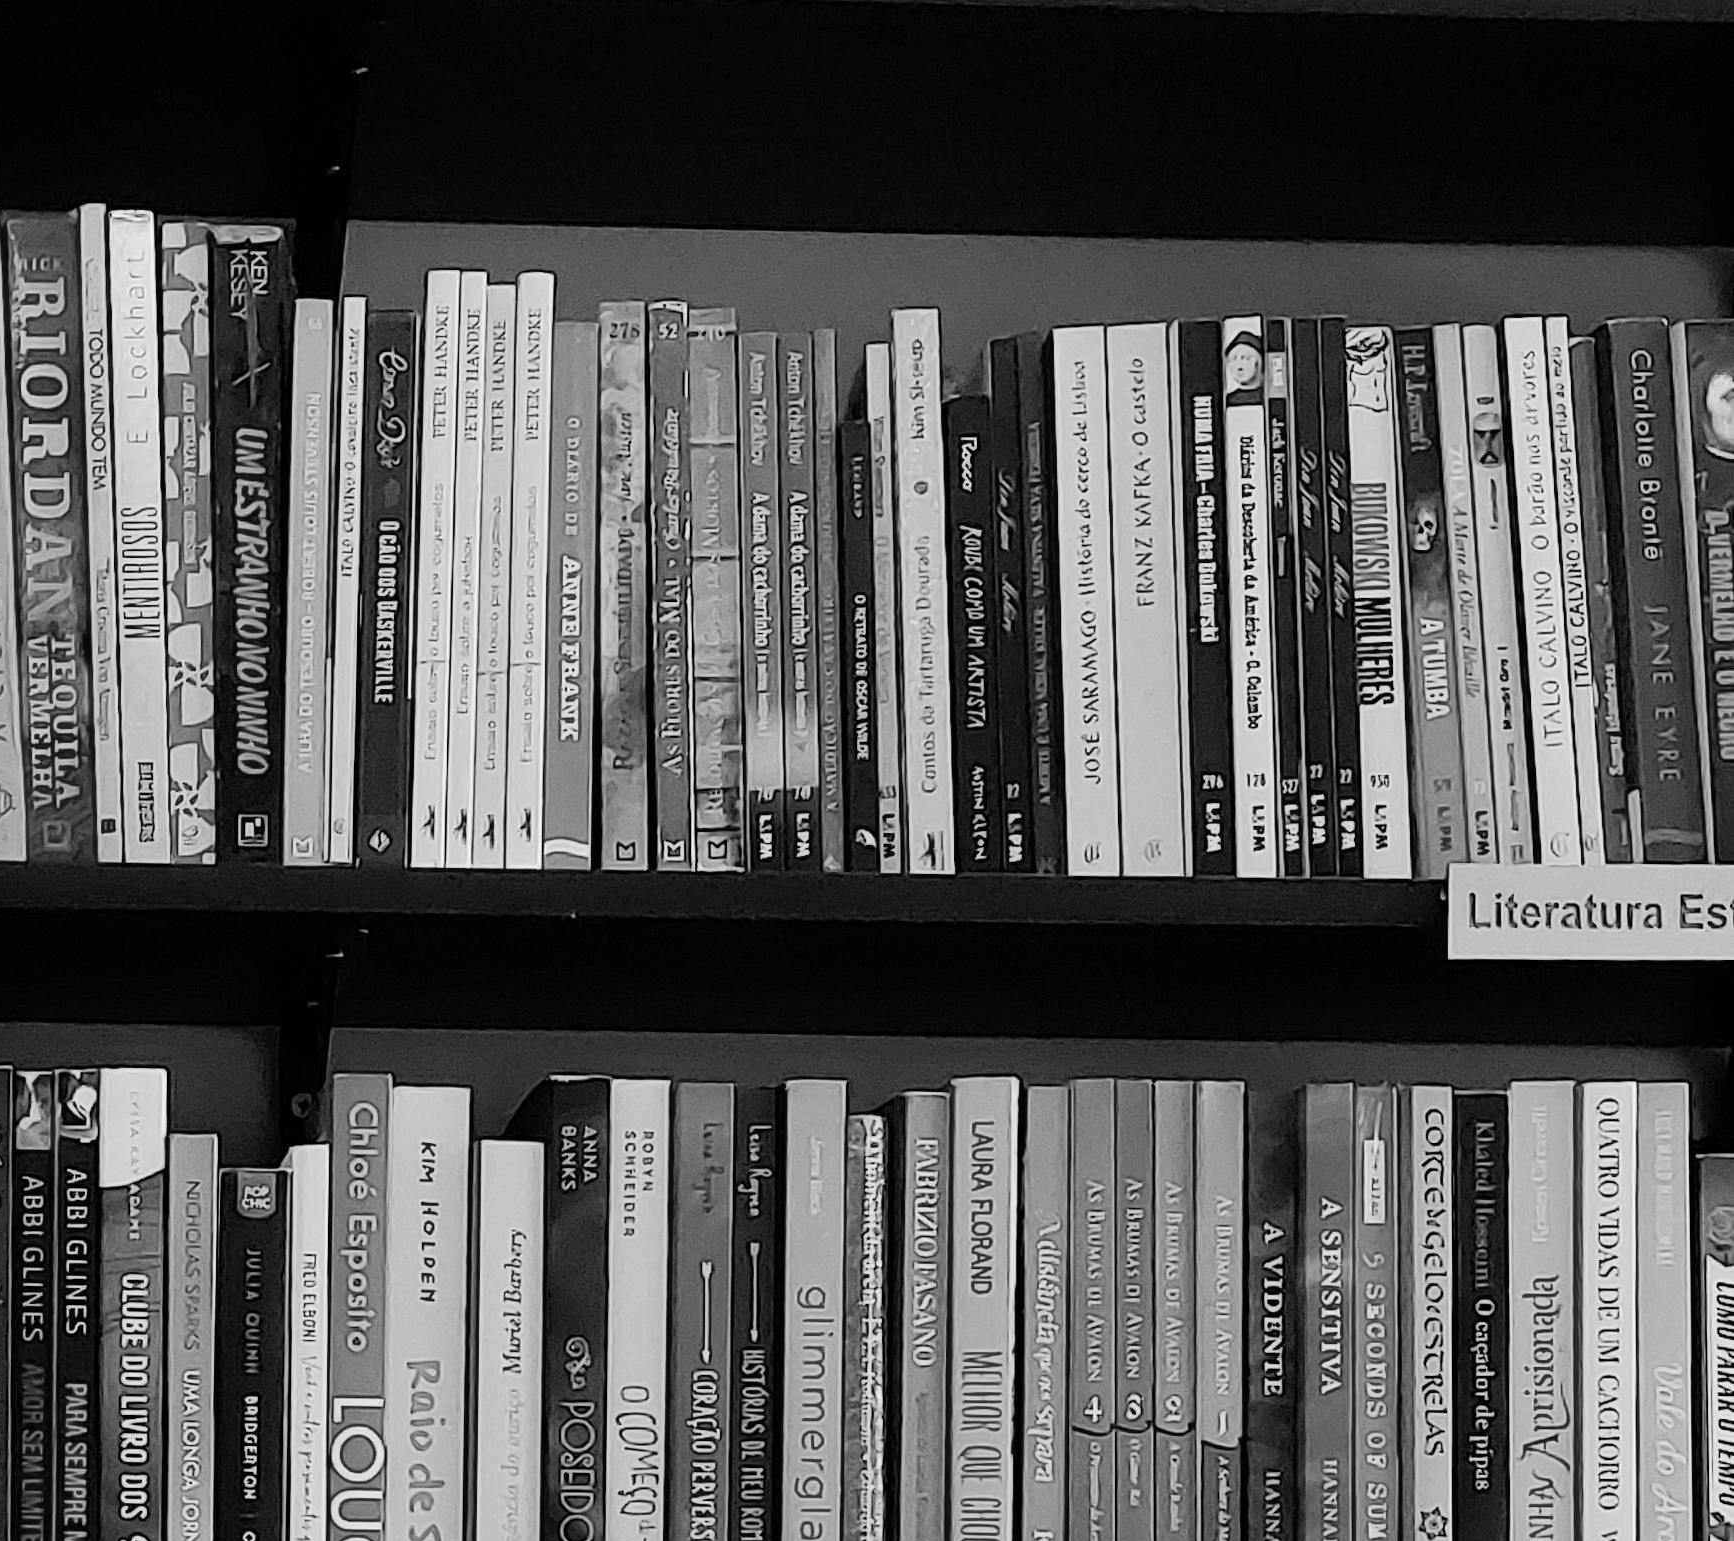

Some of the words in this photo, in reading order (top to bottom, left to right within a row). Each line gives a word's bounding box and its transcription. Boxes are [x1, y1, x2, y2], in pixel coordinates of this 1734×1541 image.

[1632, 351, 1655, 466] Charlotte
[14, 277, 75, 621] RIORDAN
[236, 428, 267, 474] UM
[121, 507, 160, 638] MENTIROSOS
[234, 479, 270, 638] ESTRANHO
[237, 642, 268, 680] NO
[1421, 619, 1443, 634] A
[1644, 606, 1673, 683] JANE
[1422, 639, 1449, 719] TUMBA
[49, 633, 80, 808] TEQUILA
[236, 679, 267, 775] NINHO
[1656, 708, 1680, 780] EYRE
[1469, 892, 1663, 930] Literatura
[1679, 893, 1734, 930] Es
[347, 1101, 380, 1199] Chloé
[972, 1122, 994, 1191] LAURA
[1597, 1098, 1619, 1197] QUATRO
[971, 1200, 993, 1294] FLORAND
[1264, 1223, 1283, 1244] A
[1599, 1208, 1619, 1277] VIDAS
[122, 1274, 148, 1347] CLUBE
[341, 1213, 372, 1352] Esposito
[1476, 1300, 1495, 1315] O
[1598, 1288, 1619, 1319] DE
[1264, 1257, 1283, 1395] VIDENTE
[1471, 1322, 1495, 1400] caçador
[1599, 1328, 1619, 1362] UM
[121, 1357, 147, 1385] DO
[407, 1361, 443, 1451] Raio
[121, 1396, 147, 1462] LIVRO
[1476, 1405, 1494, 1429] de
[1598, 1375, 1619, 1510] CACHORRO
[121, 1475, 147, 1518] DOS
[409, 1464, 445, 1512] de
[1469, 1436, 1493, 1489] pipas
